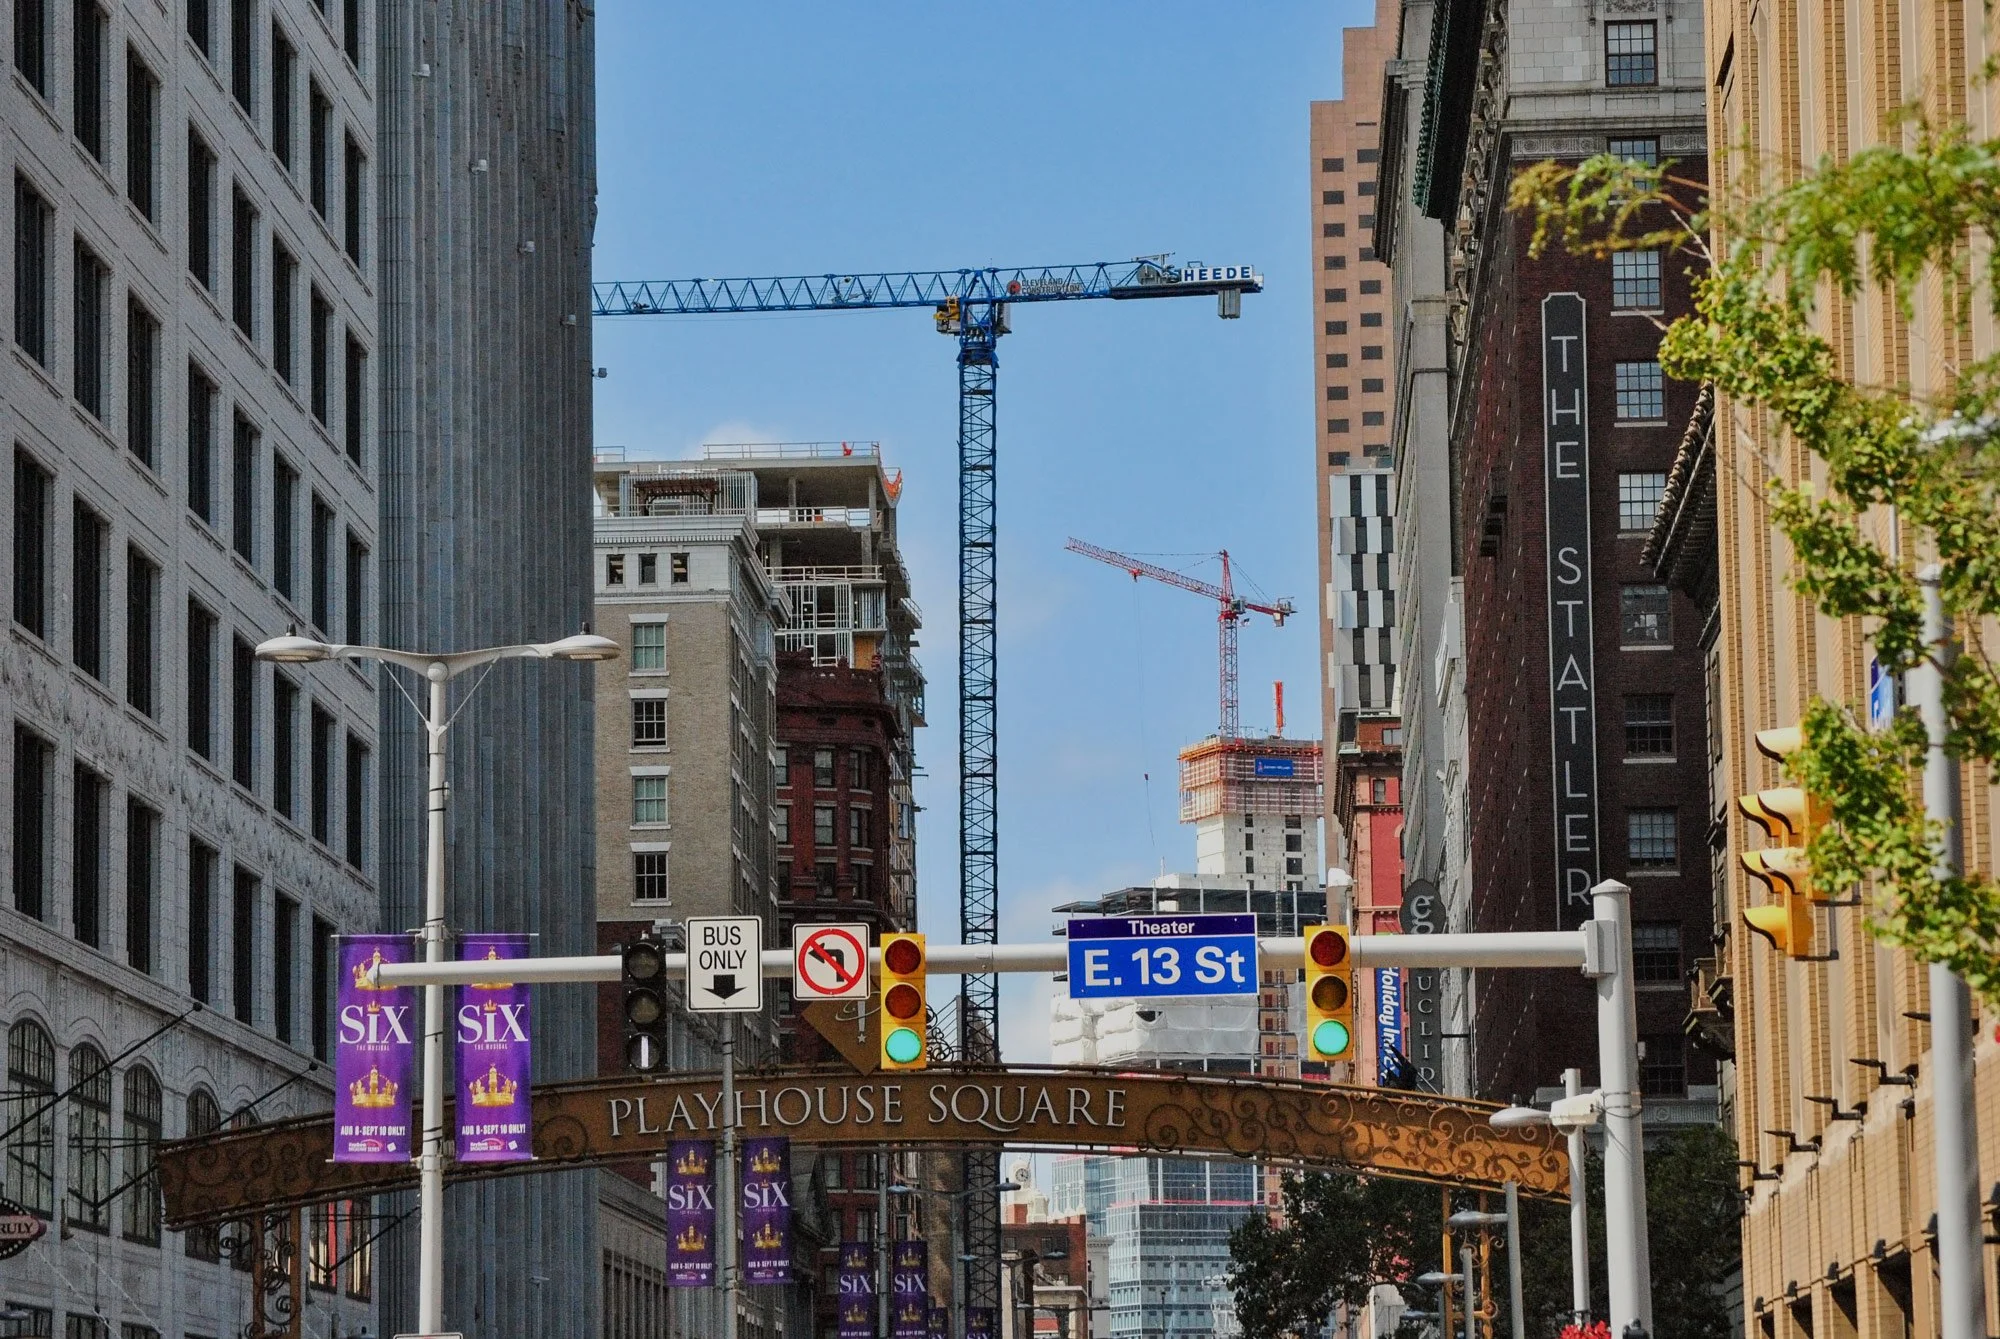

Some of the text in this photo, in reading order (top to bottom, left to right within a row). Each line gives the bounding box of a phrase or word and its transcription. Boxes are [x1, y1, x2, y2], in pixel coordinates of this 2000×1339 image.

[1184, 266, 1251, 282] HEEDE
[1551, 336, 1592, 906] THE STATLER
[703, 926, 741, 946] BUS
[1127, 920, 1196, 935] Theater
[699, 950, 747, 970] ONLY
[1084, 946, 1246, 987] E. 13 St
[1379, 967, 1400, 1026] Holiday
[1417, 975, 1436, 1082] UCLID
[609, 1084, 1127, 1137] PLAYHOUSE SQUARE
